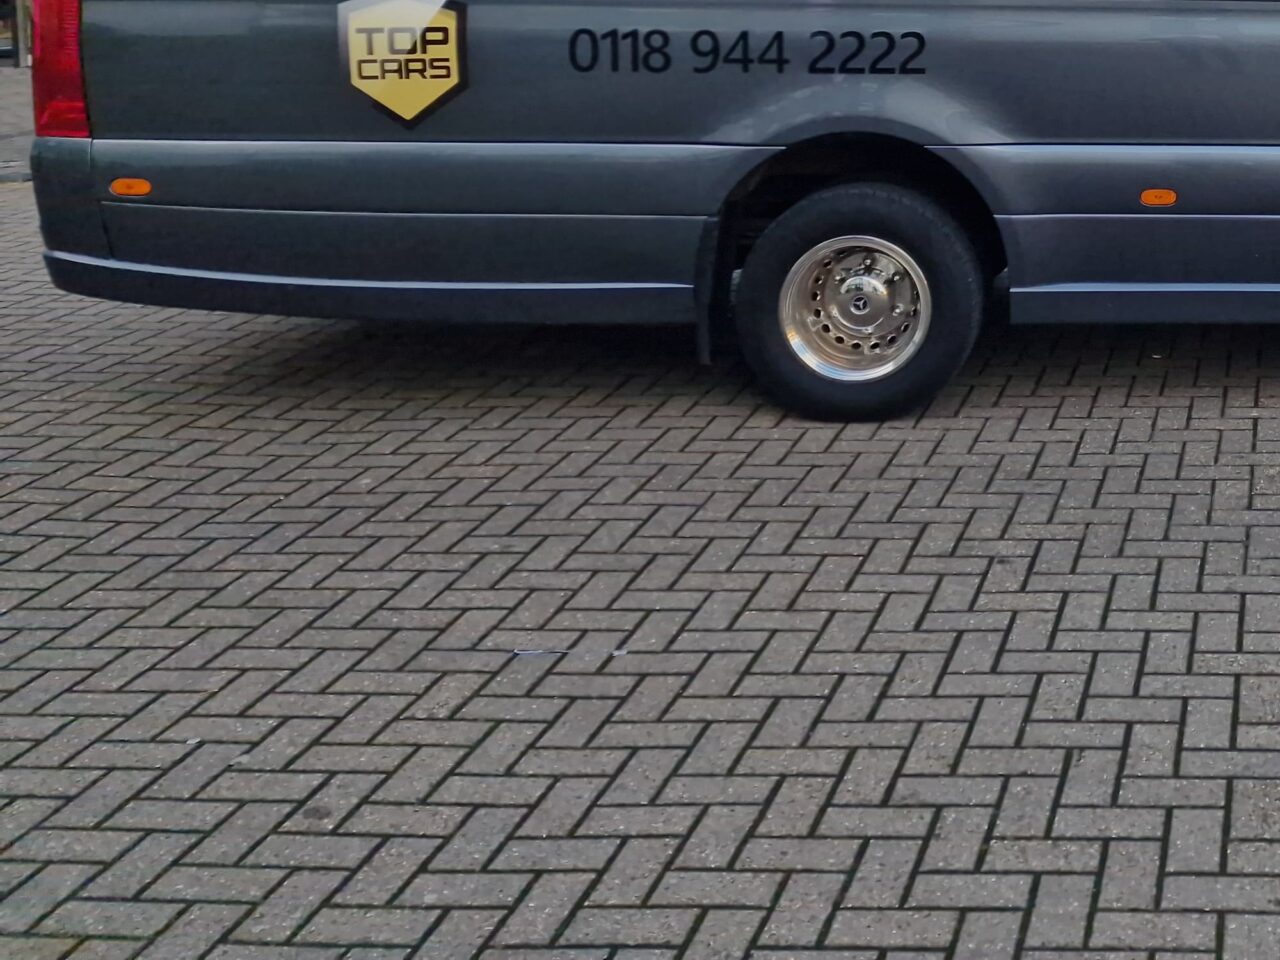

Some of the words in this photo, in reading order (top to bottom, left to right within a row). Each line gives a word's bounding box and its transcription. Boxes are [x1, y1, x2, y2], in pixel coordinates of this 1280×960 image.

[355, 26, 450, 54] TOP
[568, 27, 672, 73] 0118
[690, 30, 790, 74] 944
[807, 31, 927, 75] 2222
[356, 58, 452, 80] CARS
